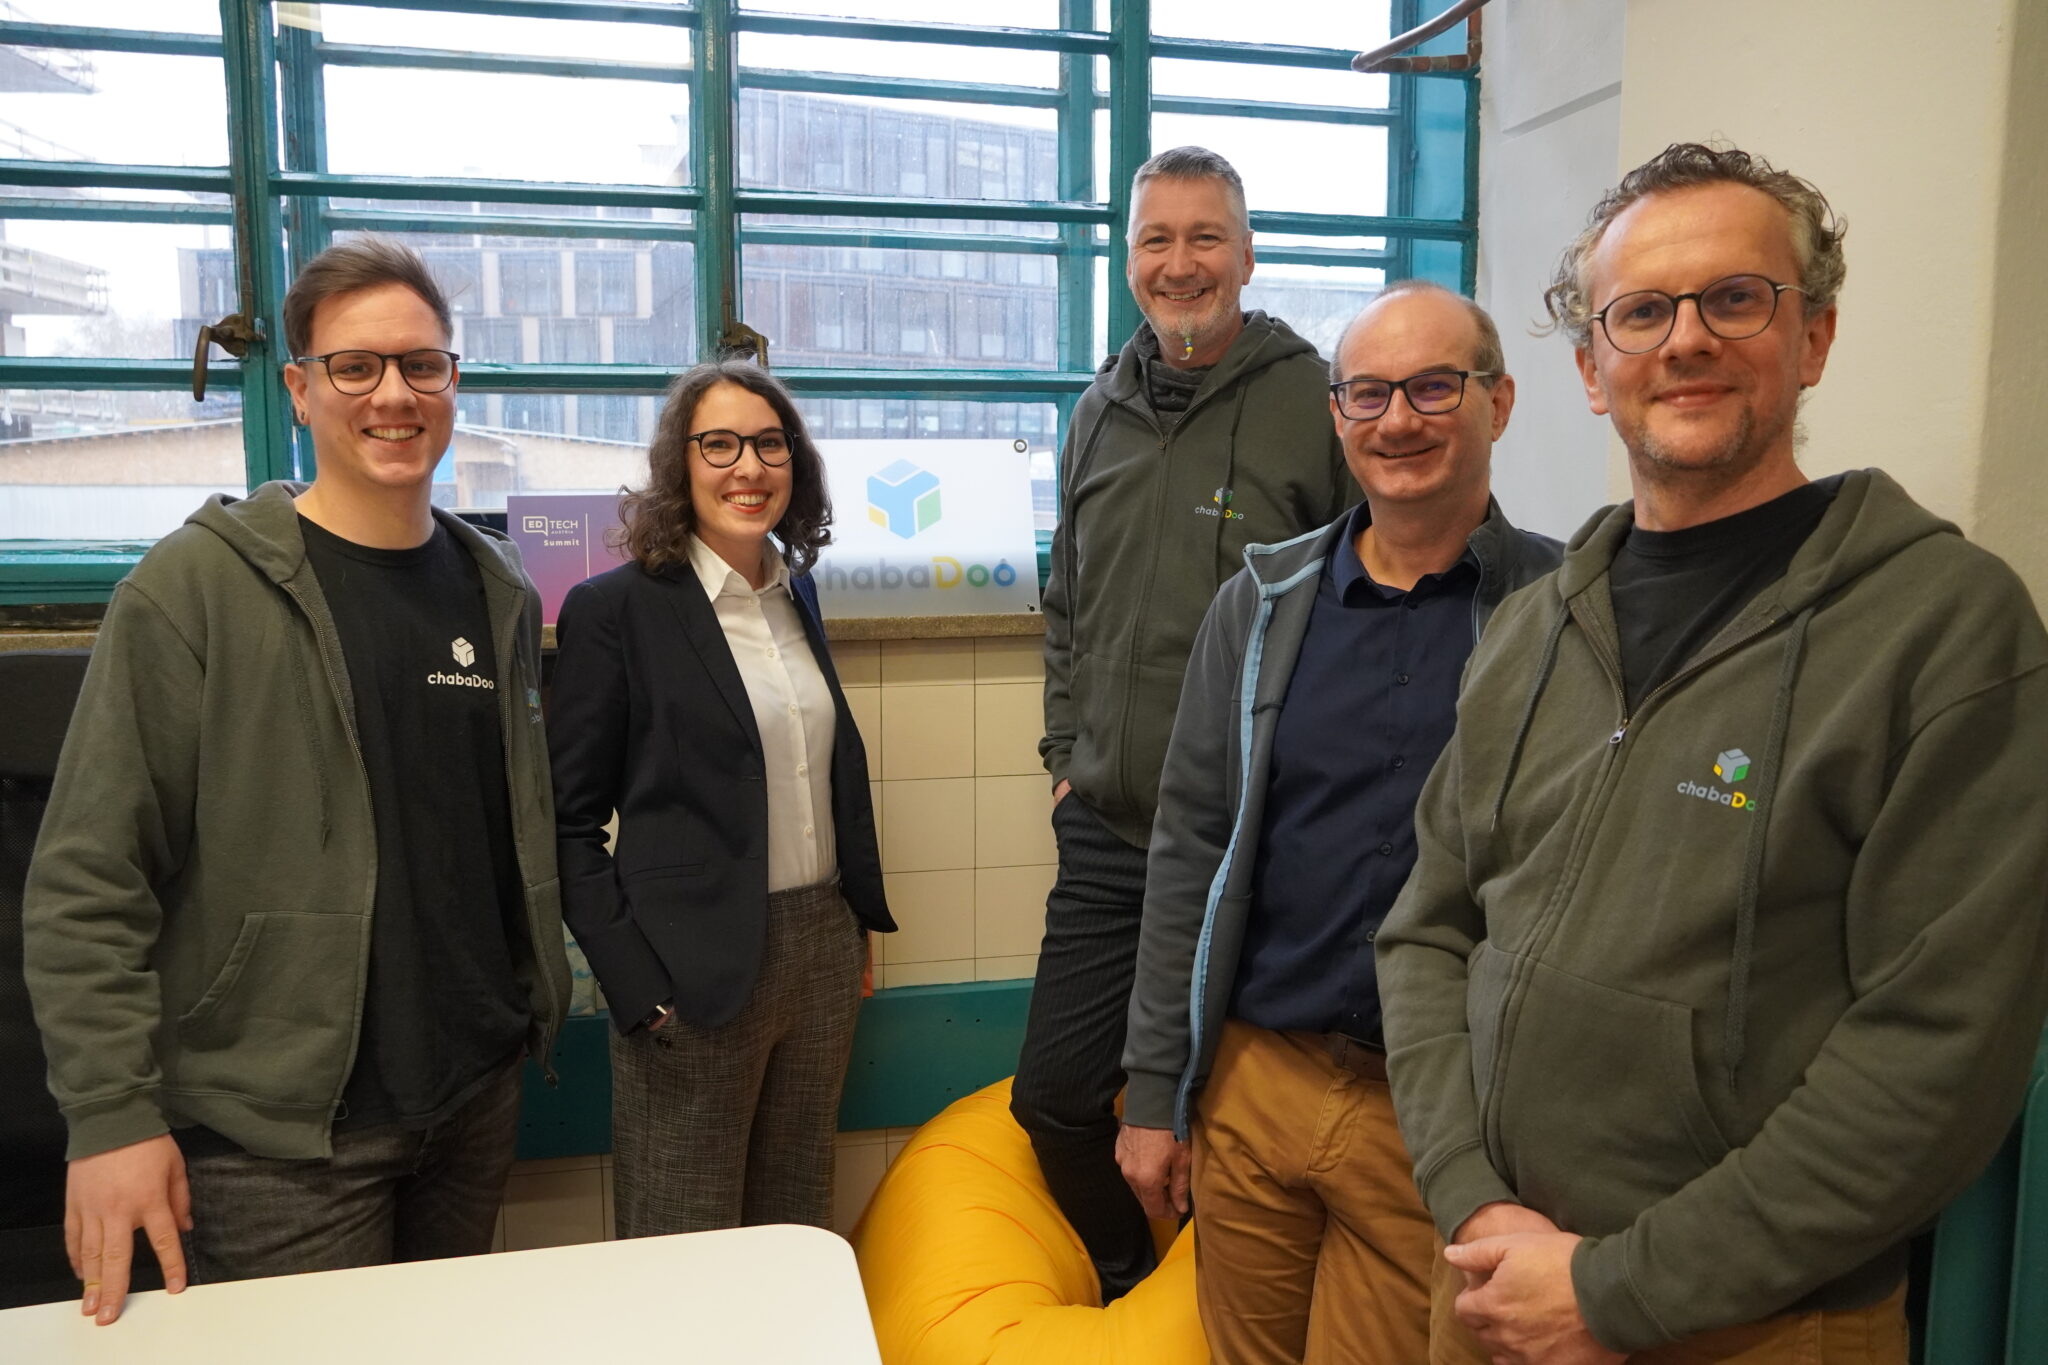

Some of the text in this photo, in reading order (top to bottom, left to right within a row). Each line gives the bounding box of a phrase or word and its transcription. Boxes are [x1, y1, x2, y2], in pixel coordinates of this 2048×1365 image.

[1194, 505, 1244, 520] chabDoo
[528, 520, 579, 529] ED TECH
[543, 538, 580, 547] Summit
[815, 556, 1017, 591] habaDoo
[427, 671, 495, 690] chabaDoo
[1677, 780, 1756, 811] chabaDo
